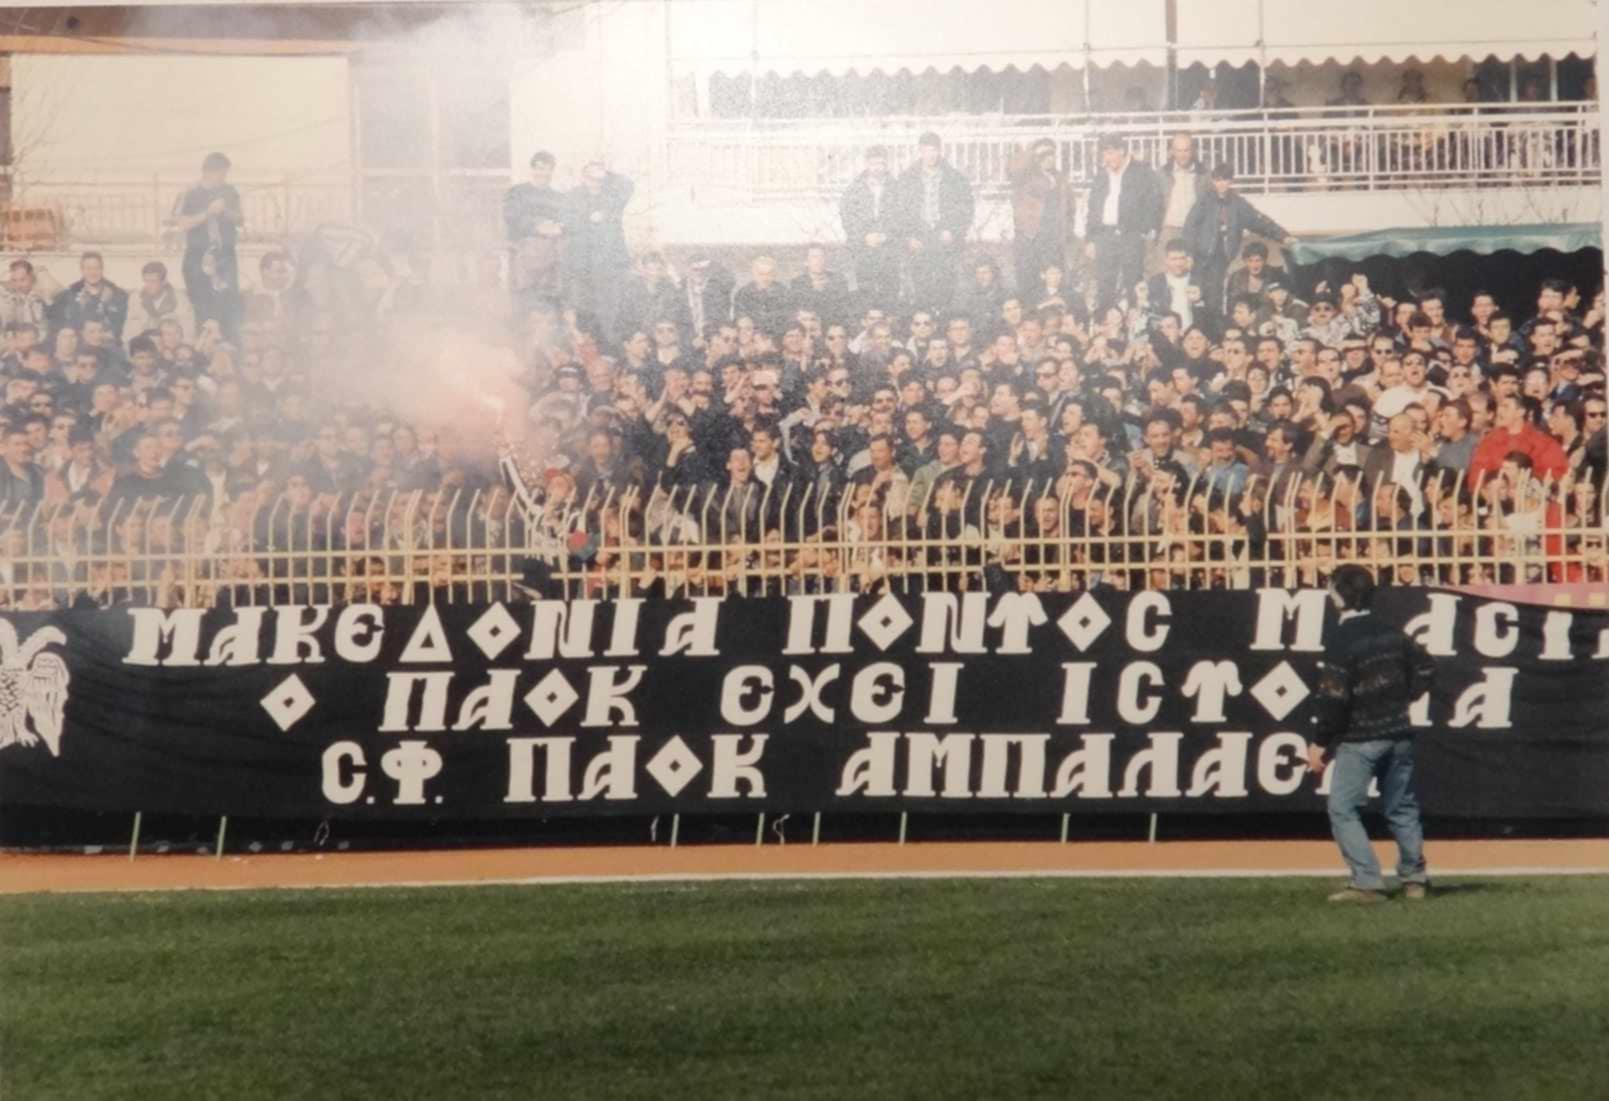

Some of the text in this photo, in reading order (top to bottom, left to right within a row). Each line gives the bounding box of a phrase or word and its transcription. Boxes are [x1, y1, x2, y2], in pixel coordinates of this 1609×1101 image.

[122, 597, 727, 666] ΜΑΚΕΔΟΝΙΑ
[260, 673, 316, 731] Ο
[378, 666, 648, 731] ΠΑΟΚ
[720, 661, 965, 726] ΕΧΕΙ
[503, 734, 769, 803] ΠΑΟΚ
[835, 732, 1380, 799] ΑΜΠΑΛΑΕ
